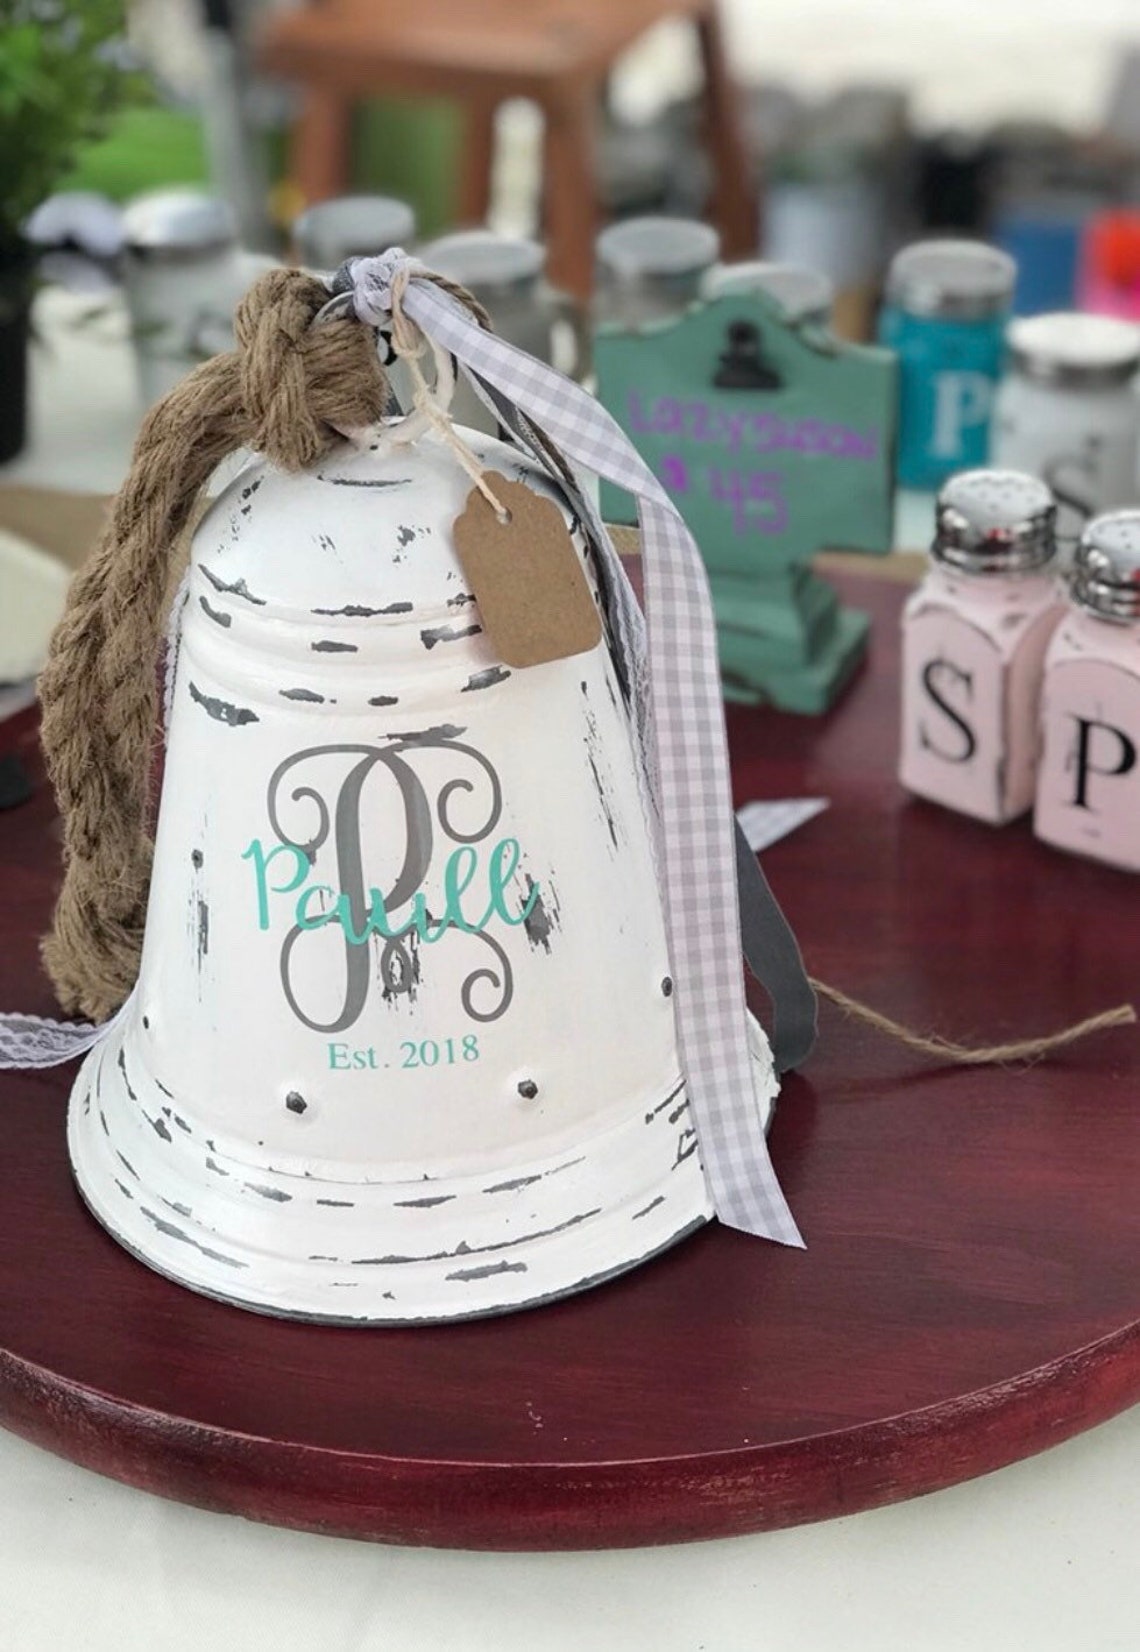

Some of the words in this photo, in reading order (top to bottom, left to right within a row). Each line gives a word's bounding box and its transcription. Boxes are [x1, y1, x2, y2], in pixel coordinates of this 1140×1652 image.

[930, 370, 992, 460] P
[921, 658, 978, 764] S
[1069, 714, 1137, 812] P
[241, 838, 540, 945] Paull
[327, 1042, 391, 1070] Est.
[400, 1034, 480, 1069] 2018
